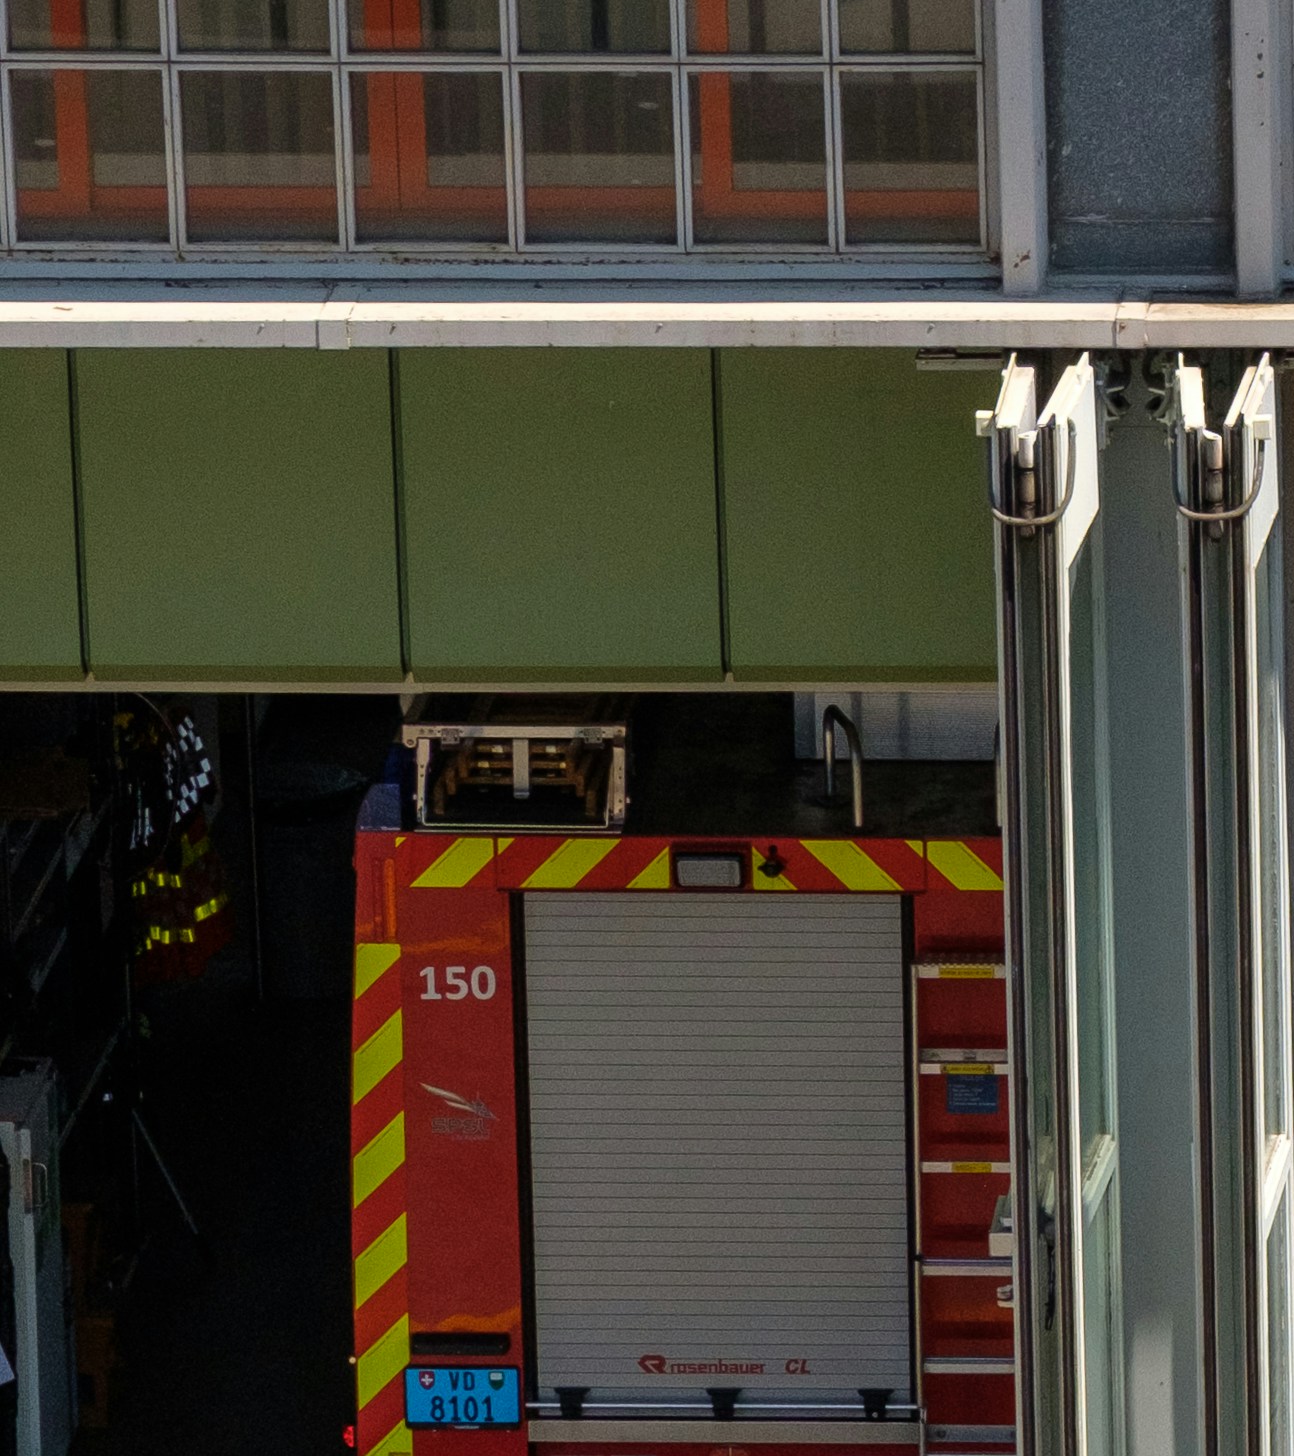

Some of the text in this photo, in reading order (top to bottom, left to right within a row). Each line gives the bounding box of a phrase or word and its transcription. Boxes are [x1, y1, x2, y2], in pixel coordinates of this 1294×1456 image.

[419, 965, 497, 1001] 150
[671, 1358, 766, 1375] rosenbauer
[448, 1371, 475, 1391] VD
[430, 1396, 494, 1421] 8101
